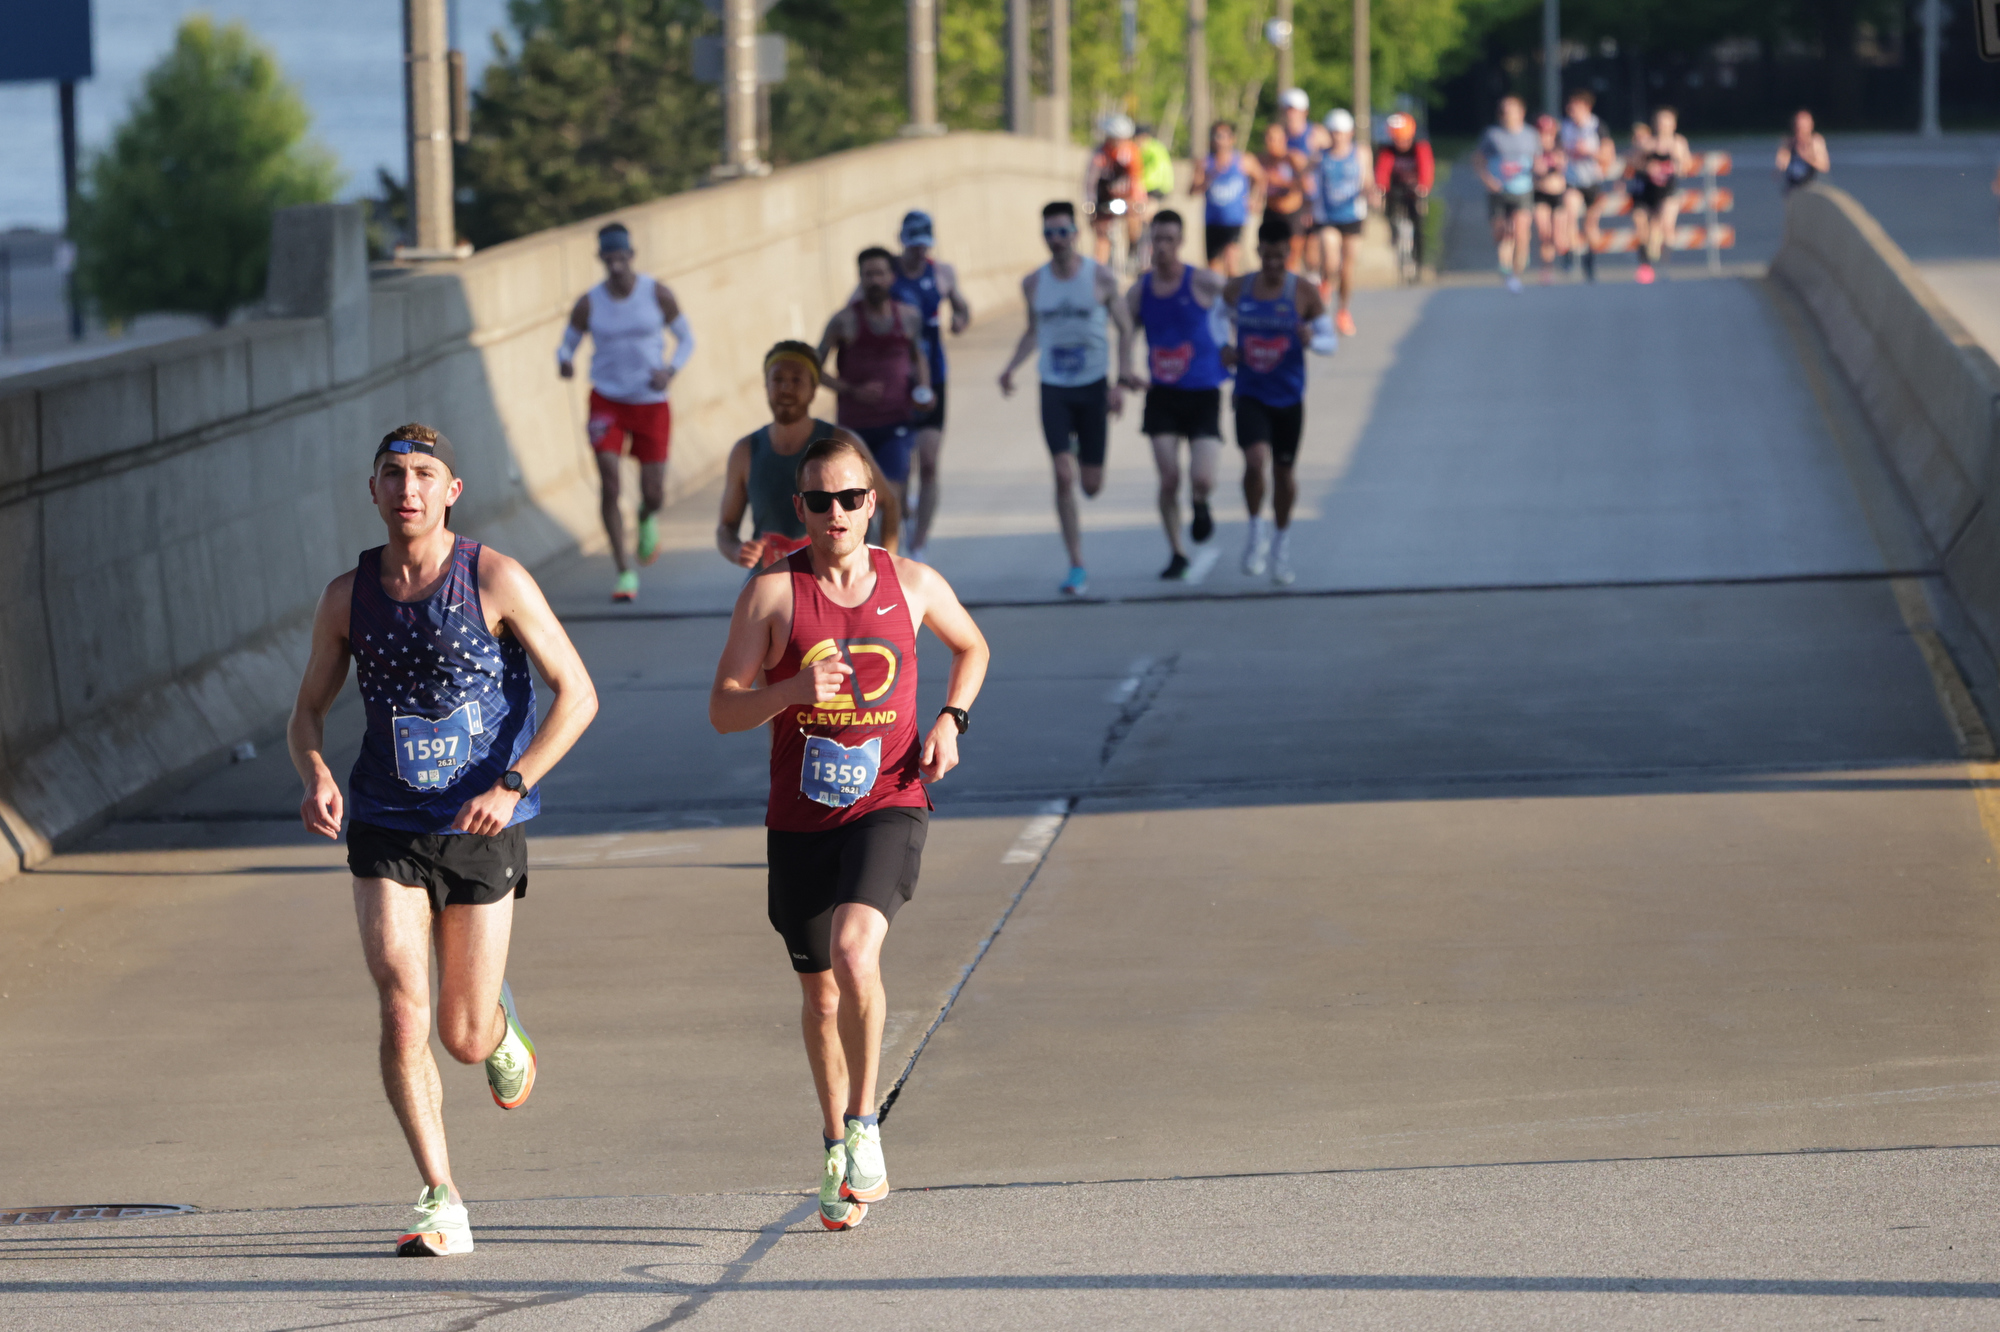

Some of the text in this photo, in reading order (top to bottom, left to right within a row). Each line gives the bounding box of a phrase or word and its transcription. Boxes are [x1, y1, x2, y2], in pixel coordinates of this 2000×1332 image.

[796, 710, 897, 725] CLEVELAND
[403, 735, 459, 761] 1597
[811, 761, 867, 786] 1359
